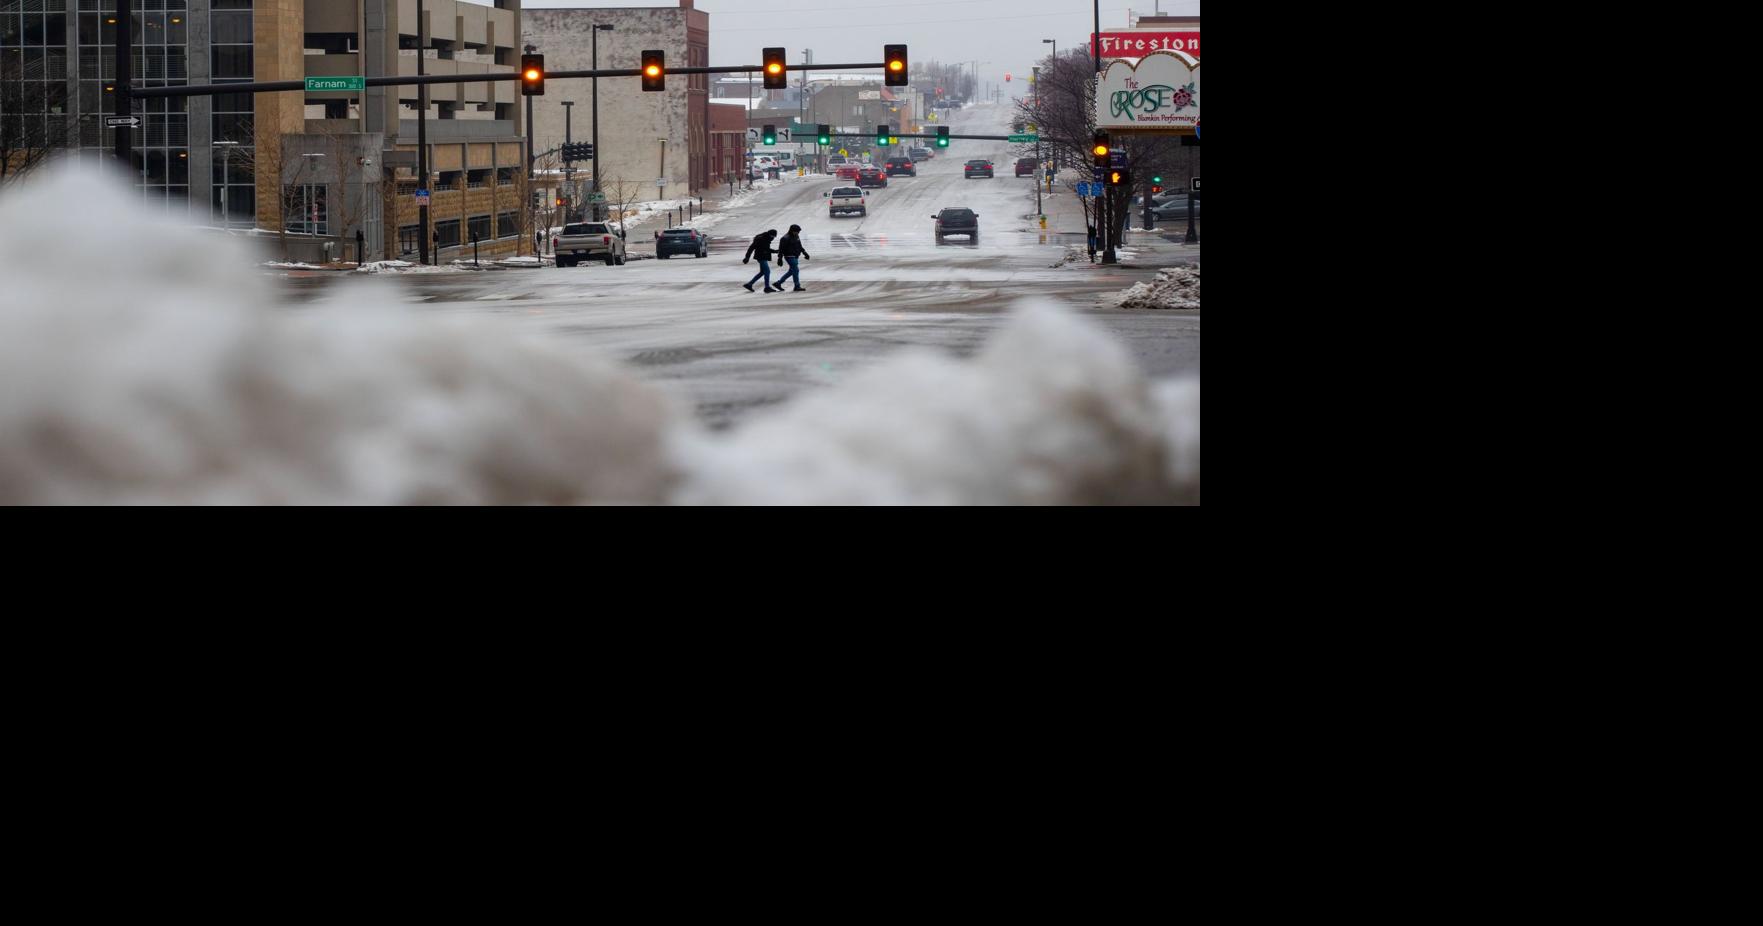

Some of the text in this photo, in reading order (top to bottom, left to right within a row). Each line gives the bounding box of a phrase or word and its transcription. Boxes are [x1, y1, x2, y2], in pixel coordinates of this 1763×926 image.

[308, 80, 346, 88] Farnam
[1124, 77, 1139, 88] The
[1110, 85, 1175, 120] ROSE
[1161, 114, 1196, 124] Performing
